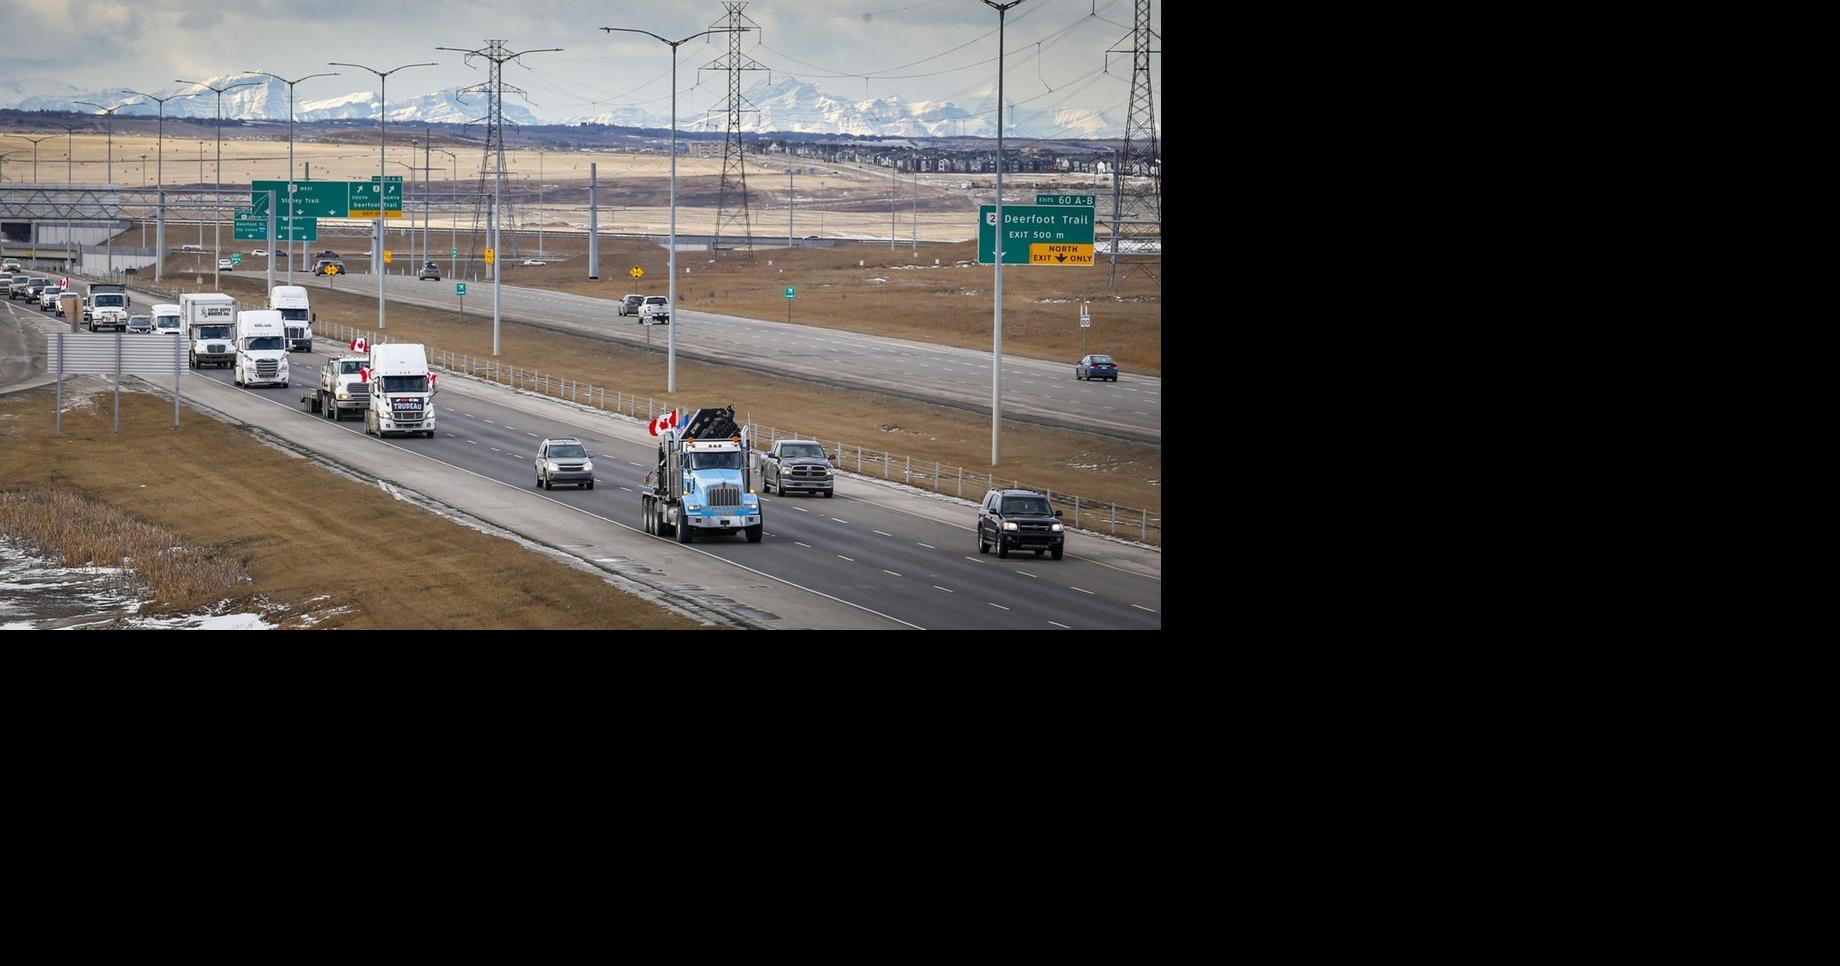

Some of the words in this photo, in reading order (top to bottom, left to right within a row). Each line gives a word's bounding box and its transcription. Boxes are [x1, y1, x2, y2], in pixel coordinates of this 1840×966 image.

[1058, 196, 1071, 205] 60
[1075, 196, 1093, 204] A-B
[990, 215, 996, 223] 2
[1004, 214, 1055, 224] Deerfoot
[1062, 215, 1088, 224] Trail
[1009, 231, 1028, 239] EXIT
[1033, 231, 1051, 239] 500
[1033, 254, 1051, 262] EXIT
